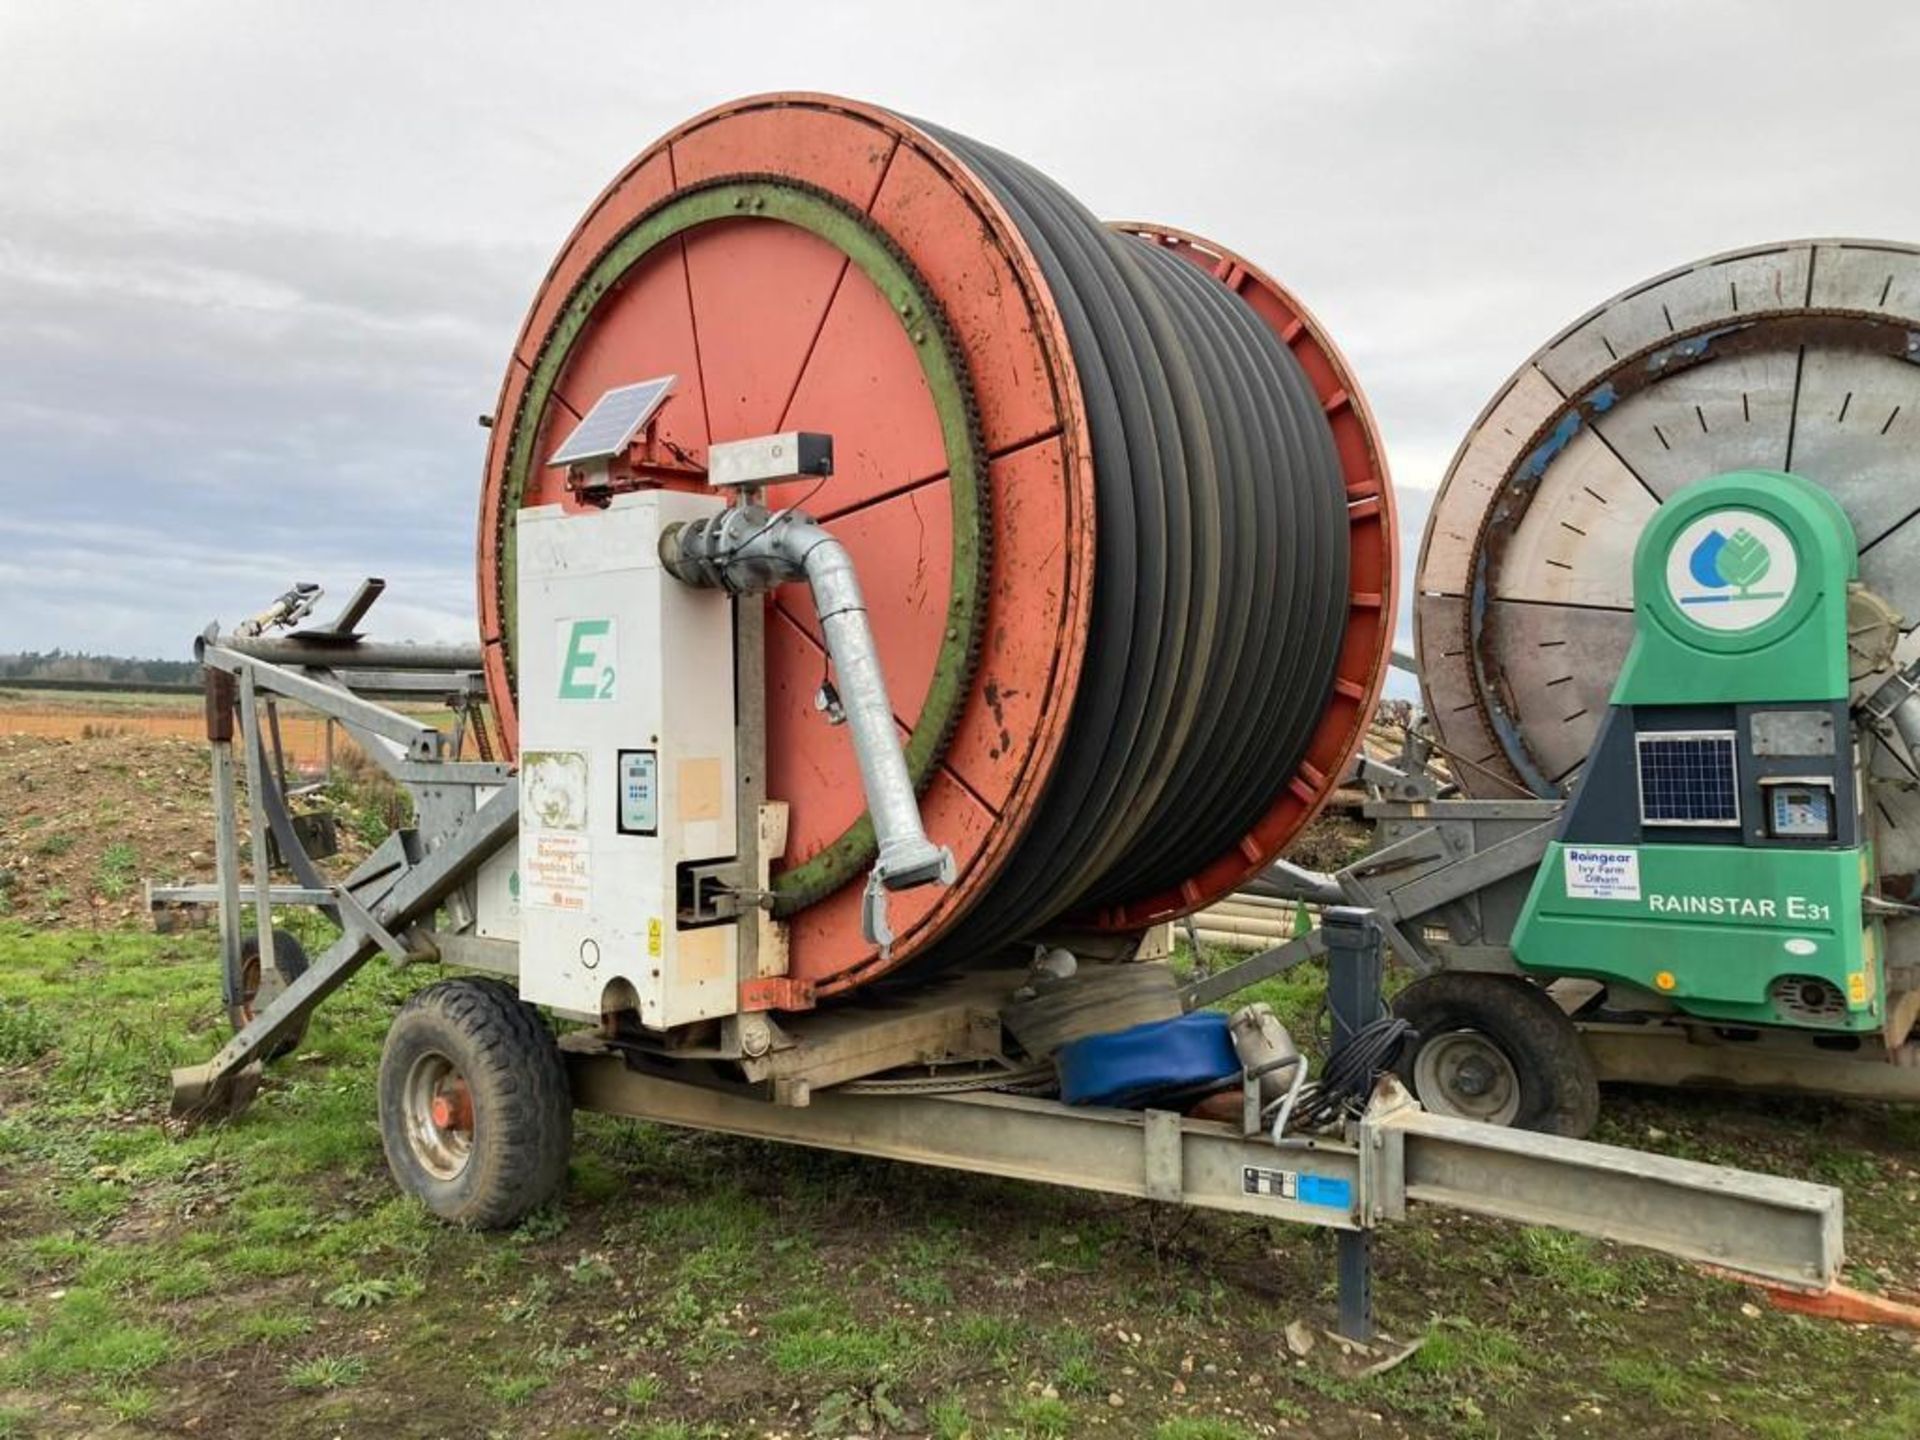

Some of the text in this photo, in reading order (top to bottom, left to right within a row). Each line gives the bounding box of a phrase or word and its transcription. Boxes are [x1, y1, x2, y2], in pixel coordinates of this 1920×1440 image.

[558, 620, 615, 699] E2
[1569, 850, 1632, 864] Raingear
[1578, 864, 1625, 874] Ivy Farm
[1649, 894, 1830, 921] RAINSTAR E31
